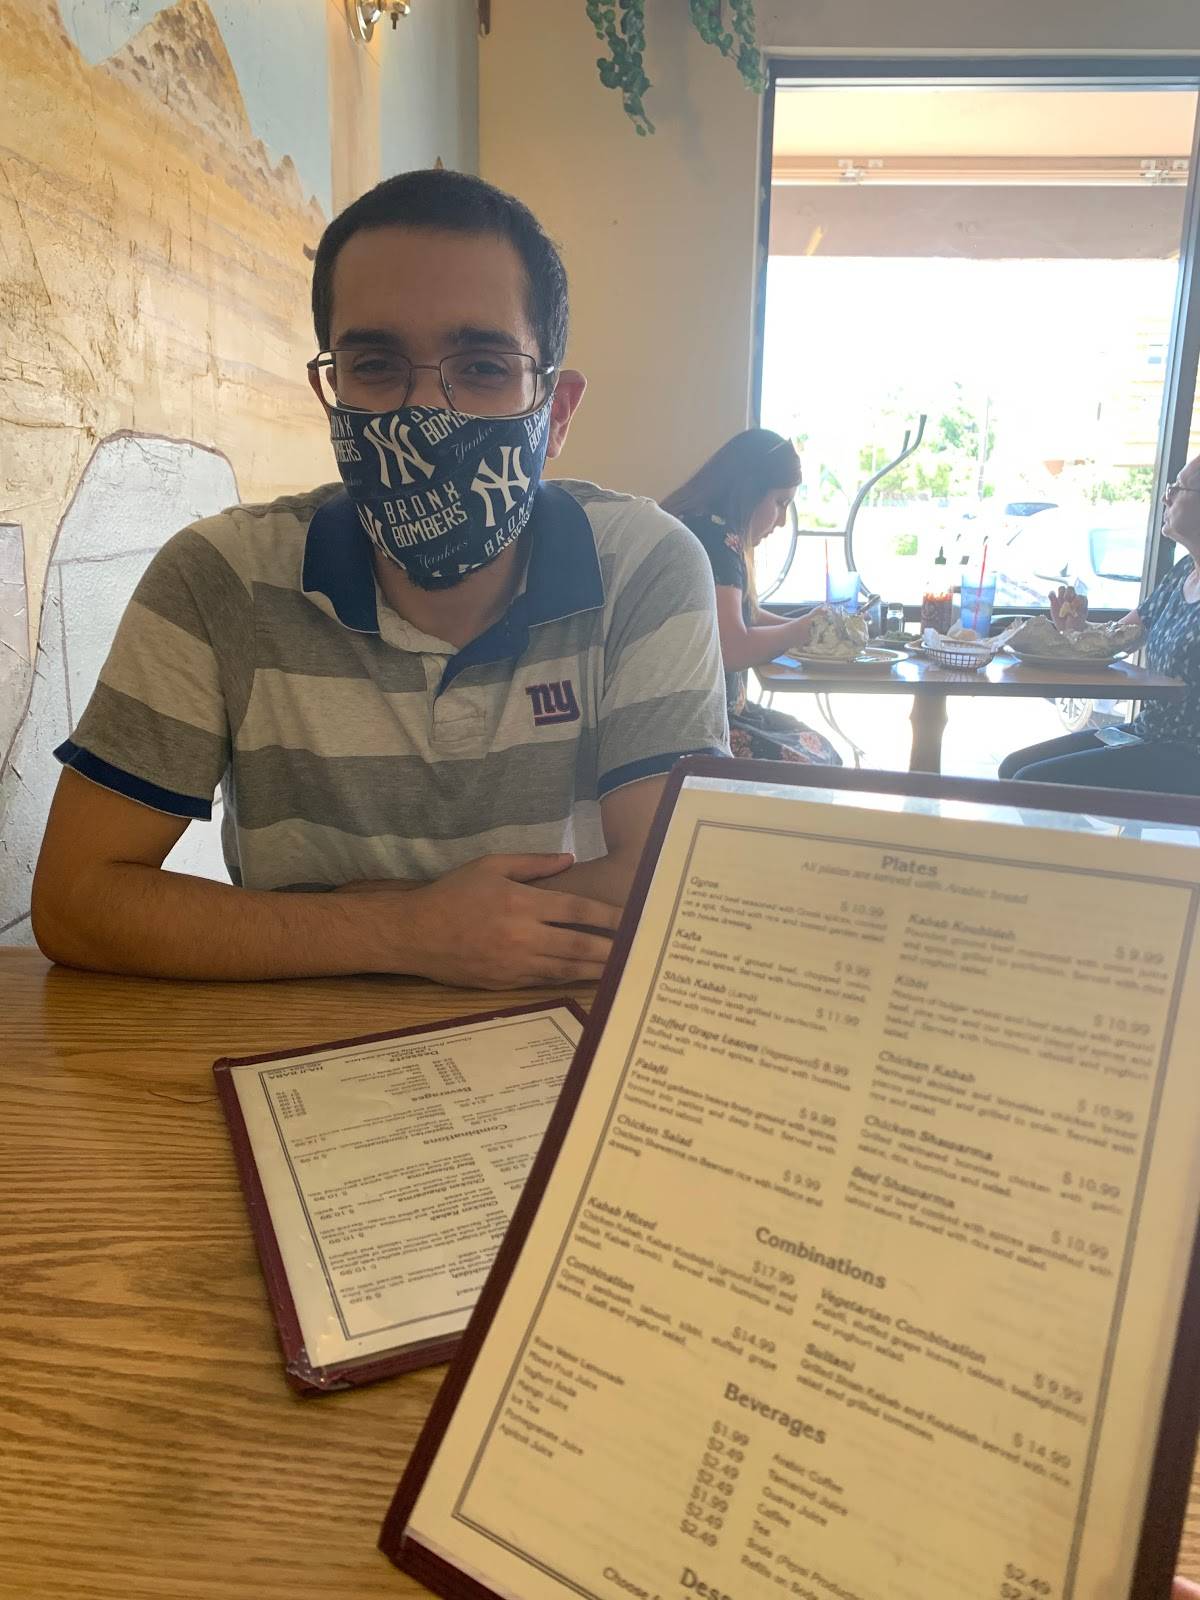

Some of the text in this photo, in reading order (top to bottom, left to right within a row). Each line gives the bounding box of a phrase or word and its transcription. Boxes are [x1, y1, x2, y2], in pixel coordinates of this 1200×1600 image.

[363, 415, 435, 489] NY
[471, 446, 530, 528] NY
[384, 481, 461, 524] BRONX
[392, 501, 468, 548] BOMBERS
[818, 864, 852, 879] plates
[873, 873, 912, 888] served
[882, 855, 938, 878] Plates
[689, 876, 719, 891] Gyros
[908, 913, 948, 930] Kabab
[675, 928, 702, 943] Kafta
[1129, 946, 1164, 965] 9.99
[663, 970, 691, 986] Shish
[694, 977, 727, 994] Kabab
[844, 962, 871, 979] 9.99
[826, 1009, 860, 1027] 11.99
[1107, 1016, 1150, 1036] 10.99
[649, 1013, 686, 1032] Stuffed
[688, 1024, 720, 1041] Grape
[722, 1033, 759, 1053] Leaves
[822, 1061, 850, 1078] 8.99
[878, 1049, 976, 1084] Chicken Kabab
[411, 1086, 472, 1102] Beverages
[809, 1109, 837, 1128] 9.99
[1092, 1103, 1134, 1124] 10.99
[423, 1124, 508, 1146] Combinations
[616, 1114, 693, 1148] Chicken Salad
[864, 1114, 993, 1161] Chicken Shawarma
[793, 1171, 821, 1192] 9.99
[852, 1166, 955, 1210] Beef Shawarma
[1078, 1176, 1120, 1199] 10.99
[587, 1197, 658, 1231] Kabab Mixed
[755, 1226, 887, 1290] Combinations
[1067, 1235, 1110, 1260] 10.99
[565, 1255, 635, 1293] Combination
[752, 1260, 796, 1286] $17.99
[820, 1287, 892, 1325] Vegetarian
[895, 1317, 987, 1364] Combination
[732, 1326, 776, 1354] $14.99
[1048, 1379, 1084, 1404] 9.99
[724, 1381, 827, 1444] Beverages
[712, 1419, 750, 1446] $1.99
[706, 1436, 744, 1463] $2.49
[1029, 1440, 1072, 1469] 14.99
[701, 1452, 739, 1480] $2.49
[696, 1468, 735, 1496] $2.49
[690, 1485, 729, 1513] $1.99
[685, 1502, 724, 1530] $2.49
[680, 1518, 718, 1548] $2.49
